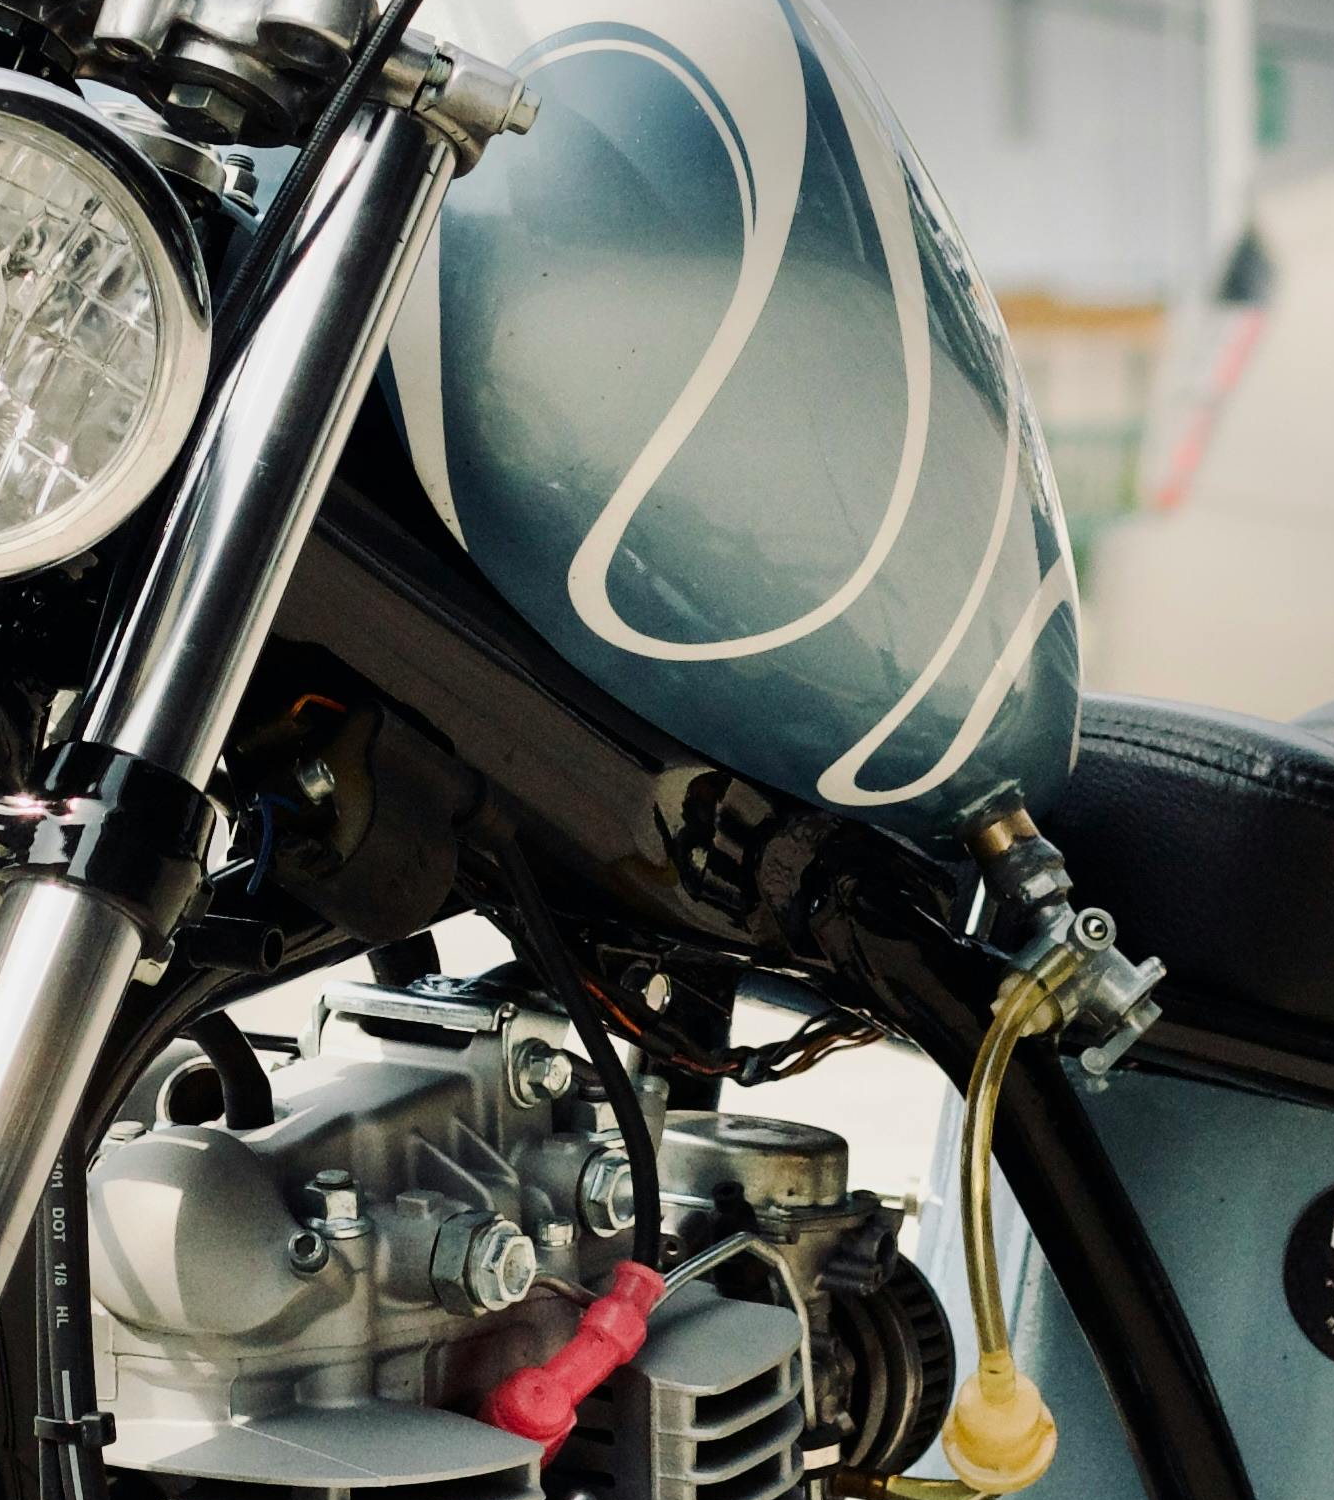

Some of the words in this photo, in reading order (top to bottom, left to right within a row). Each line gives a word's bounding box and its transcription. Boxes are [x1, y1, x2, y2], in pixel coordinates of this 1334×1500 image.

[52, 1206, 66, 1243] DOT
[53, 1262, 68, 1287] 1/8
[56, 1305, 69, 1329] HL
